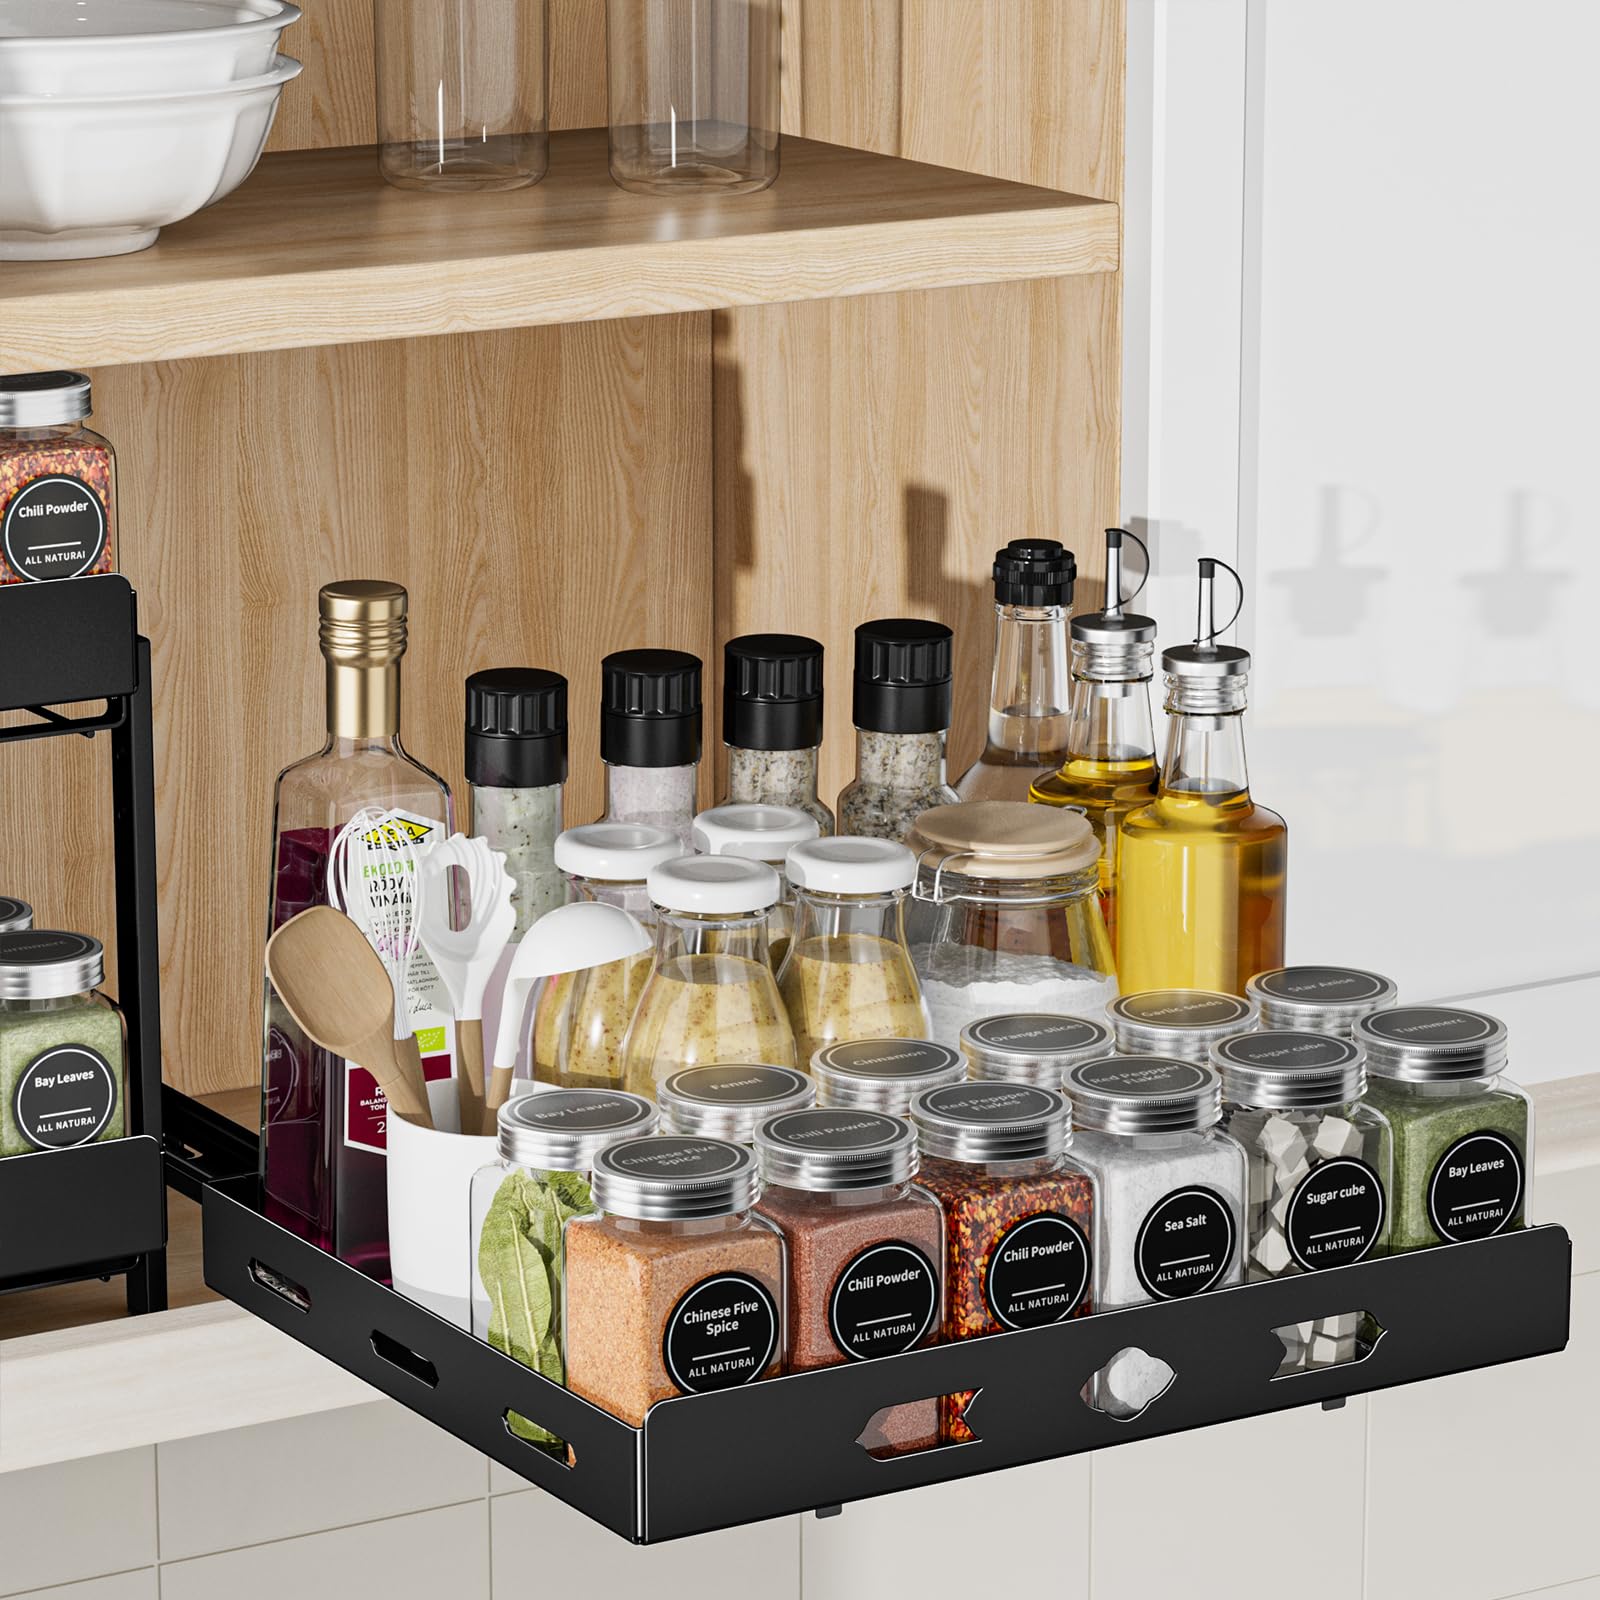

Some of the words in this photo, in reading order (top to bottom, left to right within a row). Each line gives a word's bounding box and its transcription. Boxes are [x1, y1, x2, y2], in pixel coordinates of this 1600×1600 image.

[18, 504, 44, 518] Chili
[46, 501, 89, 515] Powder
[25, 554, 42, 565] ALL
[852, 1050, 928, 1066] Cinnamon
[1248, 1049, 1290, 1060] Sugar
[1292, 1043, 1327, 1053] cube
[34, 1074, 56, 1089] Bay
[57, 1069, 95, 1084] Leaves
[535, 1110, 565, 1119] Bay
[565, 1101, 621, 1114] Leaves
[36, 1122, 54, 1133] ALL
[788, 1128, 824, 1140] Chili
[824, 1120, 882, 1134] Powder
[621, 1150, 684, 1165] Chinese
[683, 1144, 719, 1154] Five
[657, 1154, 703, 1166] Spice
[1448, 1165, 1468, 1178] Bay
[1469, 1158, 1505, 1174] Leaves
[1306, 1190, 1338, 1207] Sugar
[1339, 1183, 1366, 1199] cube
[1164, 1218, 1185, 1232] Sea
[1185, 1213, 1207, 1228] Salt
[1447, 1217, 1464, 1227] ALL
[1003, 1246, 1029, 1263] Chili
[1030, 1239, 1075, 1258] Powder
[1306, 1244, 1323, 1255] ALL
[847, 1276, 875, 1293] Chili
[876, 1268, 921, 1288] Powder
[1156, 1270, 1173, 1283] ALL
[683, 1307, 732, 1325] Chinese
[732, 1300, 759, 1316] Five
[1008, 1302, 1026, 1314] ALL
[705, 1319, 739, 1336] Spice
[852, 1332, 871, 1344] ALL
[688, 1366, 708, 1379] ALL
